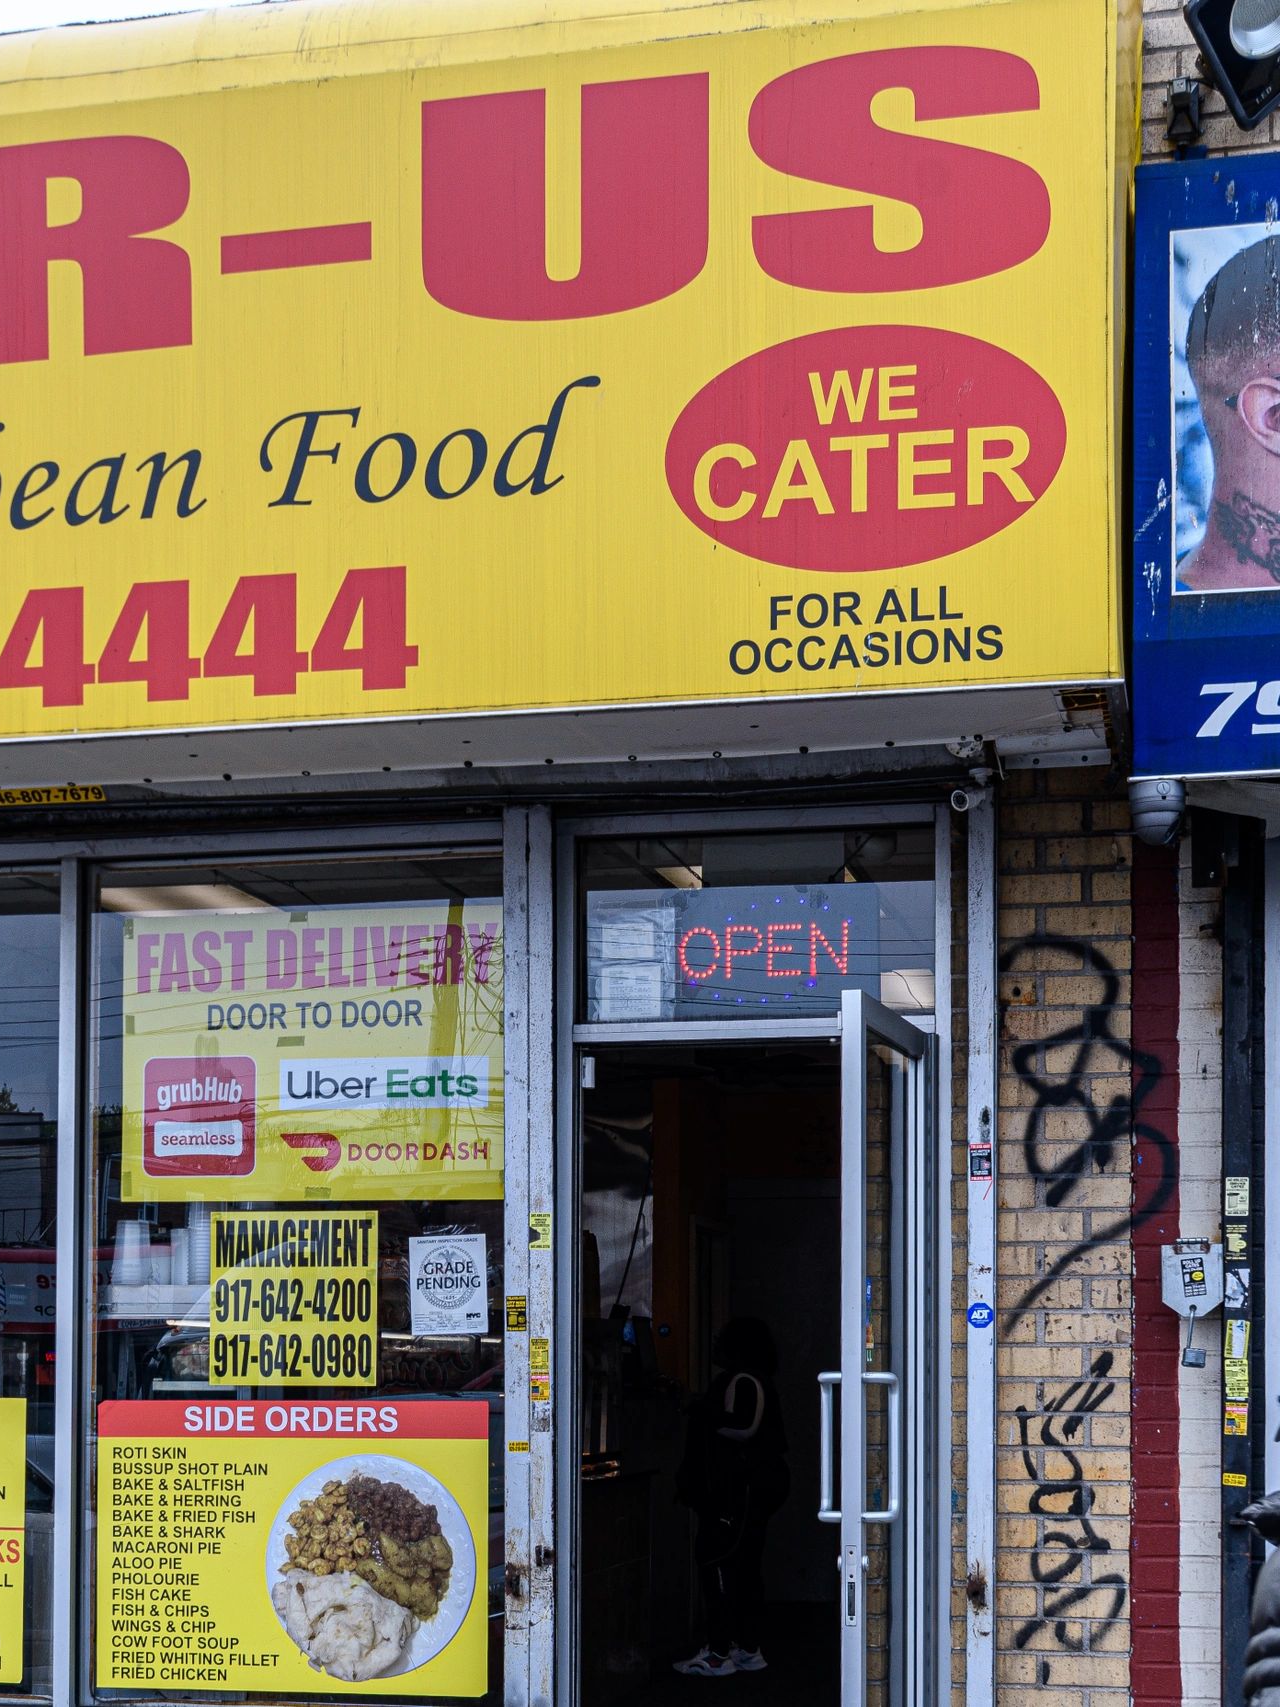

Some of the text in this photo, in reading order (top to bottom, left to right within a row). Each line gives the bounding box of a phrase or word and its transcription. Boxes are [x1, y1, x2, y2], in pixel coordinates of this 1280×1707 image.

[809, 365, 918, 425] WE
[259, 376, 601, 507] Food
[693, 425, 1036, 521] CATER
[769, 586, 964, 630] FOR ALL
[729, 624, 1004, 675] OCCASIONS
[678, 921, 849, 978] OPEN
[138, 922, 498, 994] FAST DELIVERY
[208, 1000, 422, 1030] DOOR TO DOOR
[287, 1069, 478, 1099] Uber Eats
[157, 1073, 242, 1110] grubHub
[161, 1131, 235, 1147] seamless
[348, 1141, 488, 1161] DOORDASH
[215, 1220, 372, 1268] MANAGEMENT
[424, 1261, 473, 1275] GRADE
[417, 1276, 480, 1290] PENDING
[215, 1279, 371, 1324] 917-642-4200
[971, 1309, 990, 1319] ADT
[213, 1334, 371, 1378] 917-642-0980
[184, 1406, 398, 1432] SIDE ORDERS
[113, 1447, 186, 1459] ROTI SKIN
[113, 1463, 267, 1475] BUSSUP SHOT PLAIN
[113, 1478, 244, 1491] BAKE & SALTFISH
[113, 1494, 241, 1507] BAKE & HERRING
[113, 1510, 255, 1523] BAKE & FRIED FISH
[113, 1525, 225, 1538] BAKE & SHARK
[113, 1541, 221, 1554] MACARONI PIE
[112, 1557, 182, 1569] ALOO PIE
[113, 1573, 199, 1585] PHOLOURIE
[112, 1588, 190, 1601] FISH CAKE
[112, 1604, 209, 1617] FISH & CHIPS
[112, 1620, 216, 1633] WINGS & CHIP
[112, 1635, 239, 1649] COW FOOT SOUP
[112, 1651, 279, 1666] FRIED WHITING FILLET
[112, 1667, 226, 1681] FRIED CHICKEN
